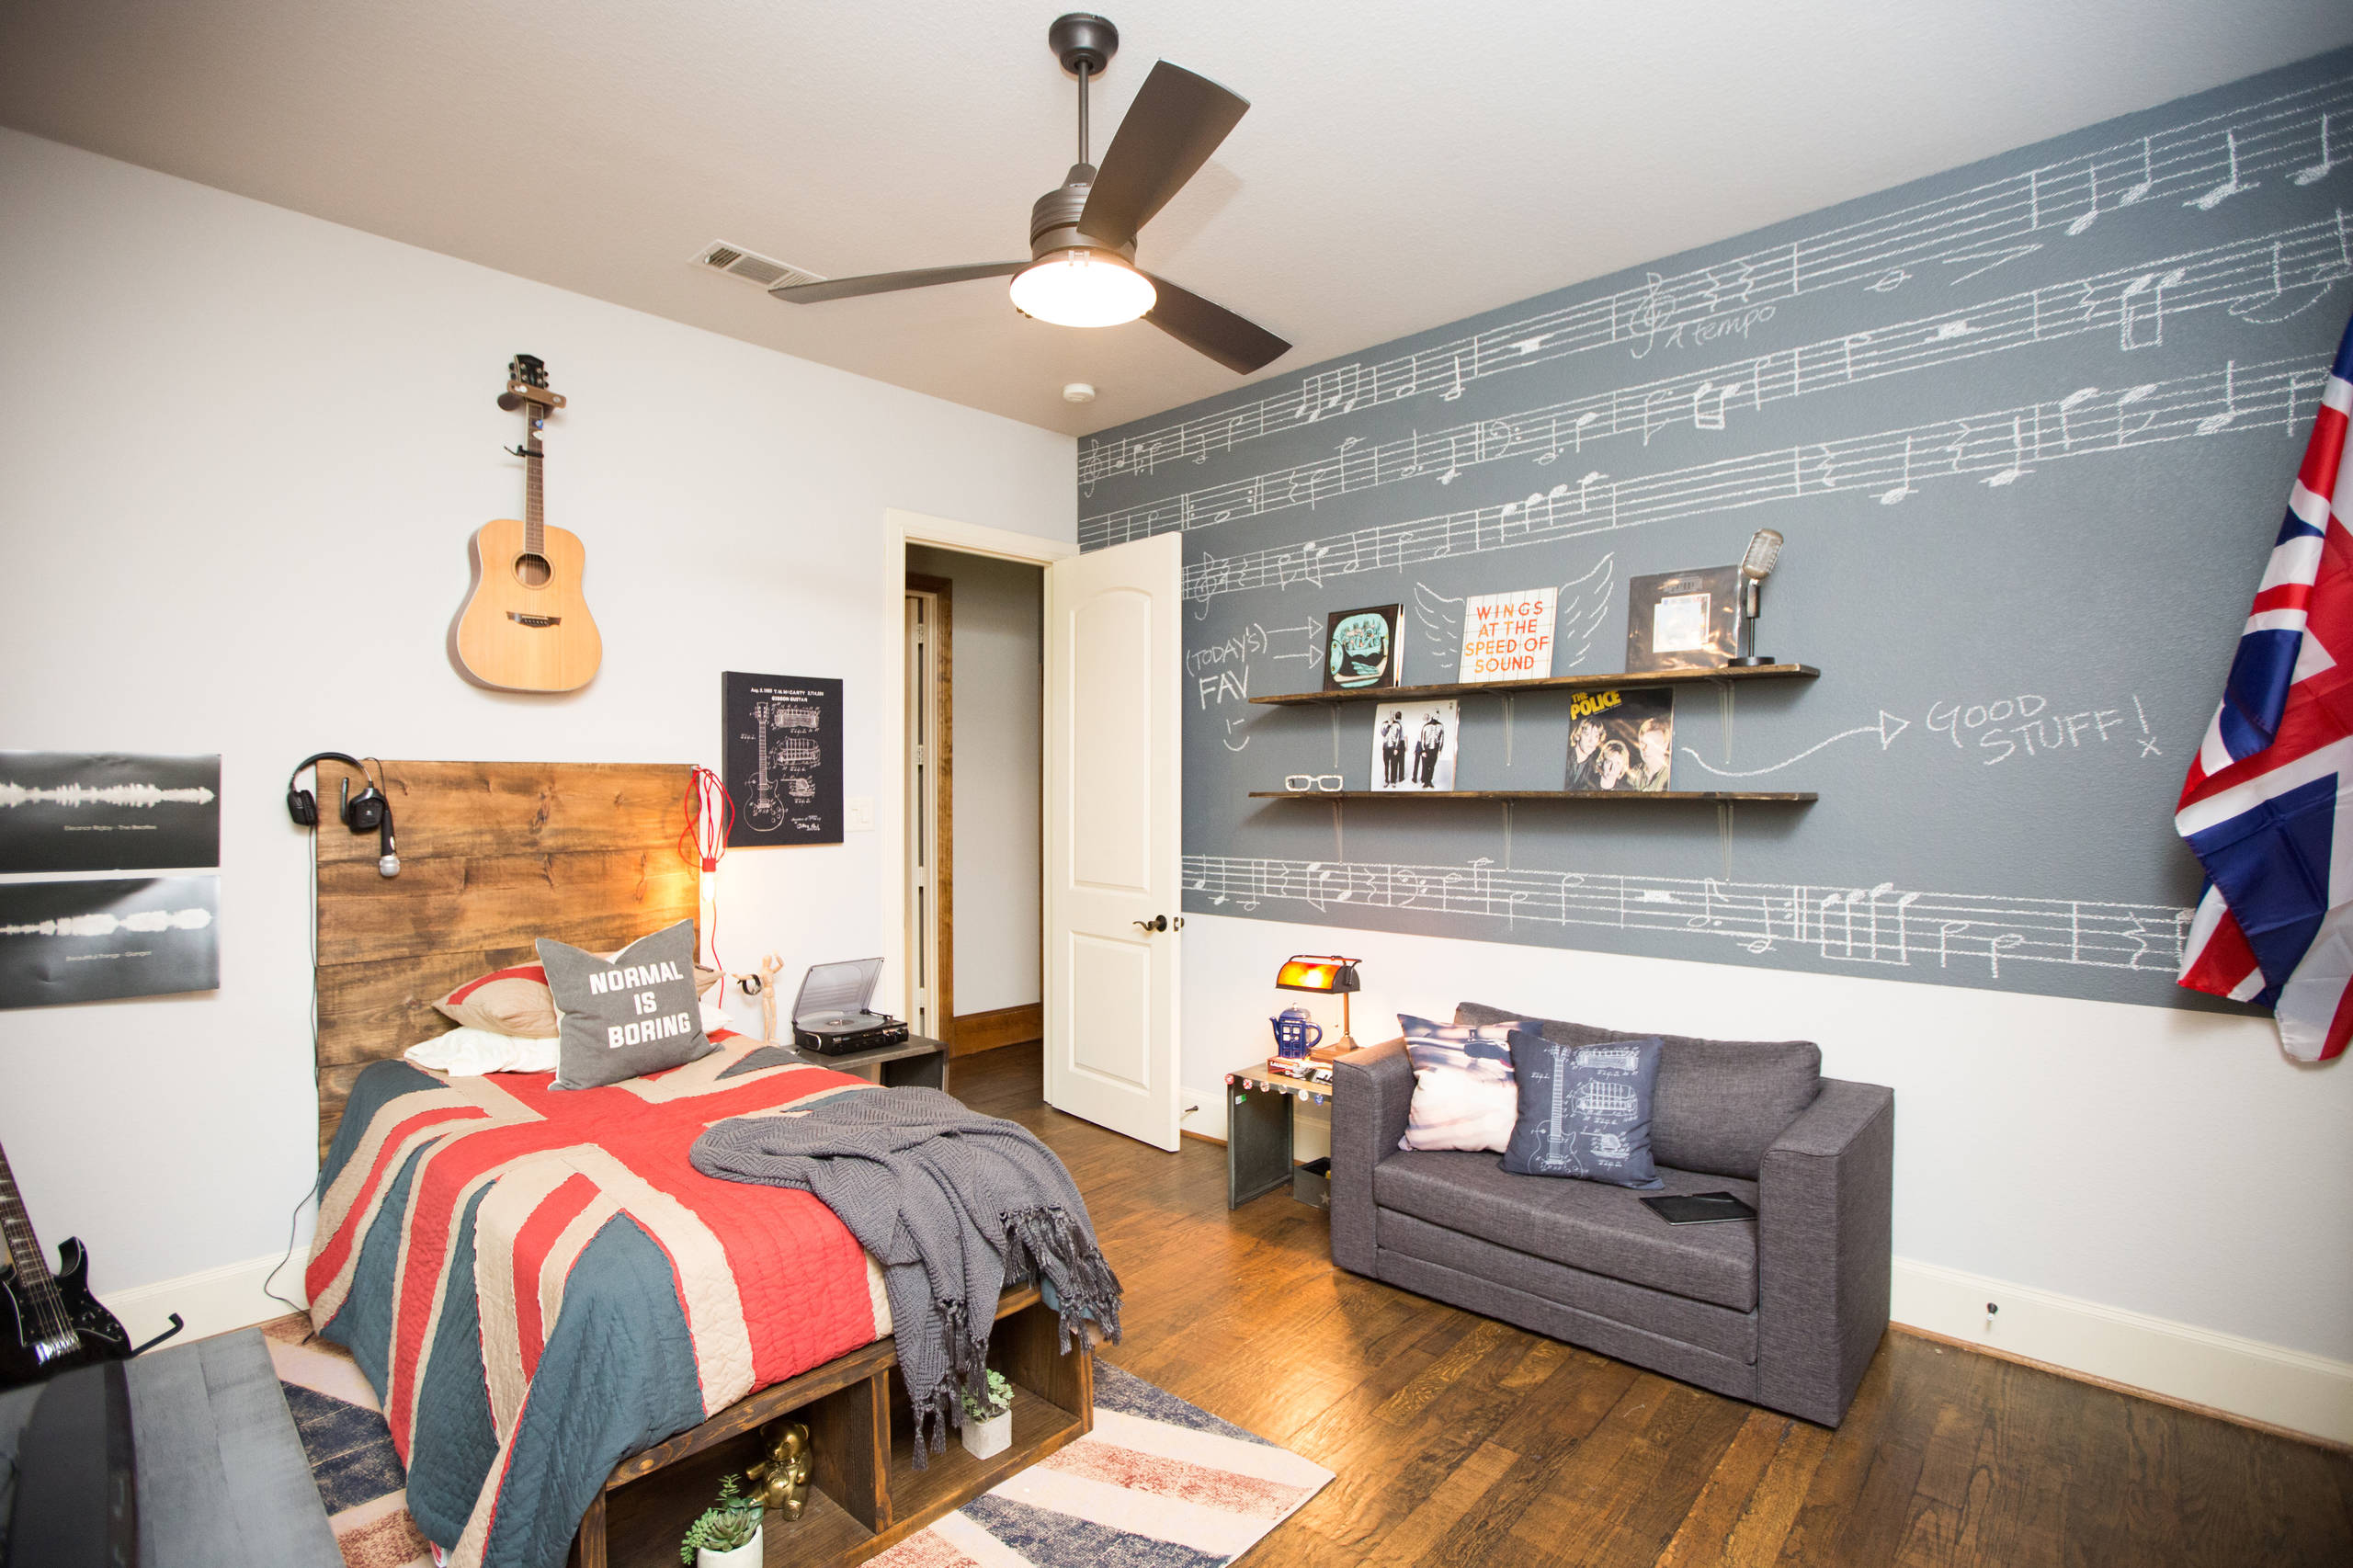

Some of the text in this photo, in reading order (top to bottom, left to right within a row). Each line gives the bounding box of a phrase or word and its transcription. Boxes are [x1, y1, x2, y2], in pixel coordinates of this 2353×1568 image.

[1692, 306, 1777, 346] tempo
[1476, 600, 1544, 620] WINGS
[1478, 619, 1538, 638] AT THE
[1464, 635, 1550, 656] SPEED OF
[1474, 655, 1534, 674] SOUND
[1199, 665, 1249, 710] FAV
[1572, 691, 1588, 703] THE
[1570, 690, 1622, 721] POLICE
[1927, 694, 2046, 749] GOOD
[589, 960, 685, 995] NORMAL
[633, 991, 657, 1016] IS
[608, 1012, 691, 1049] BORING
